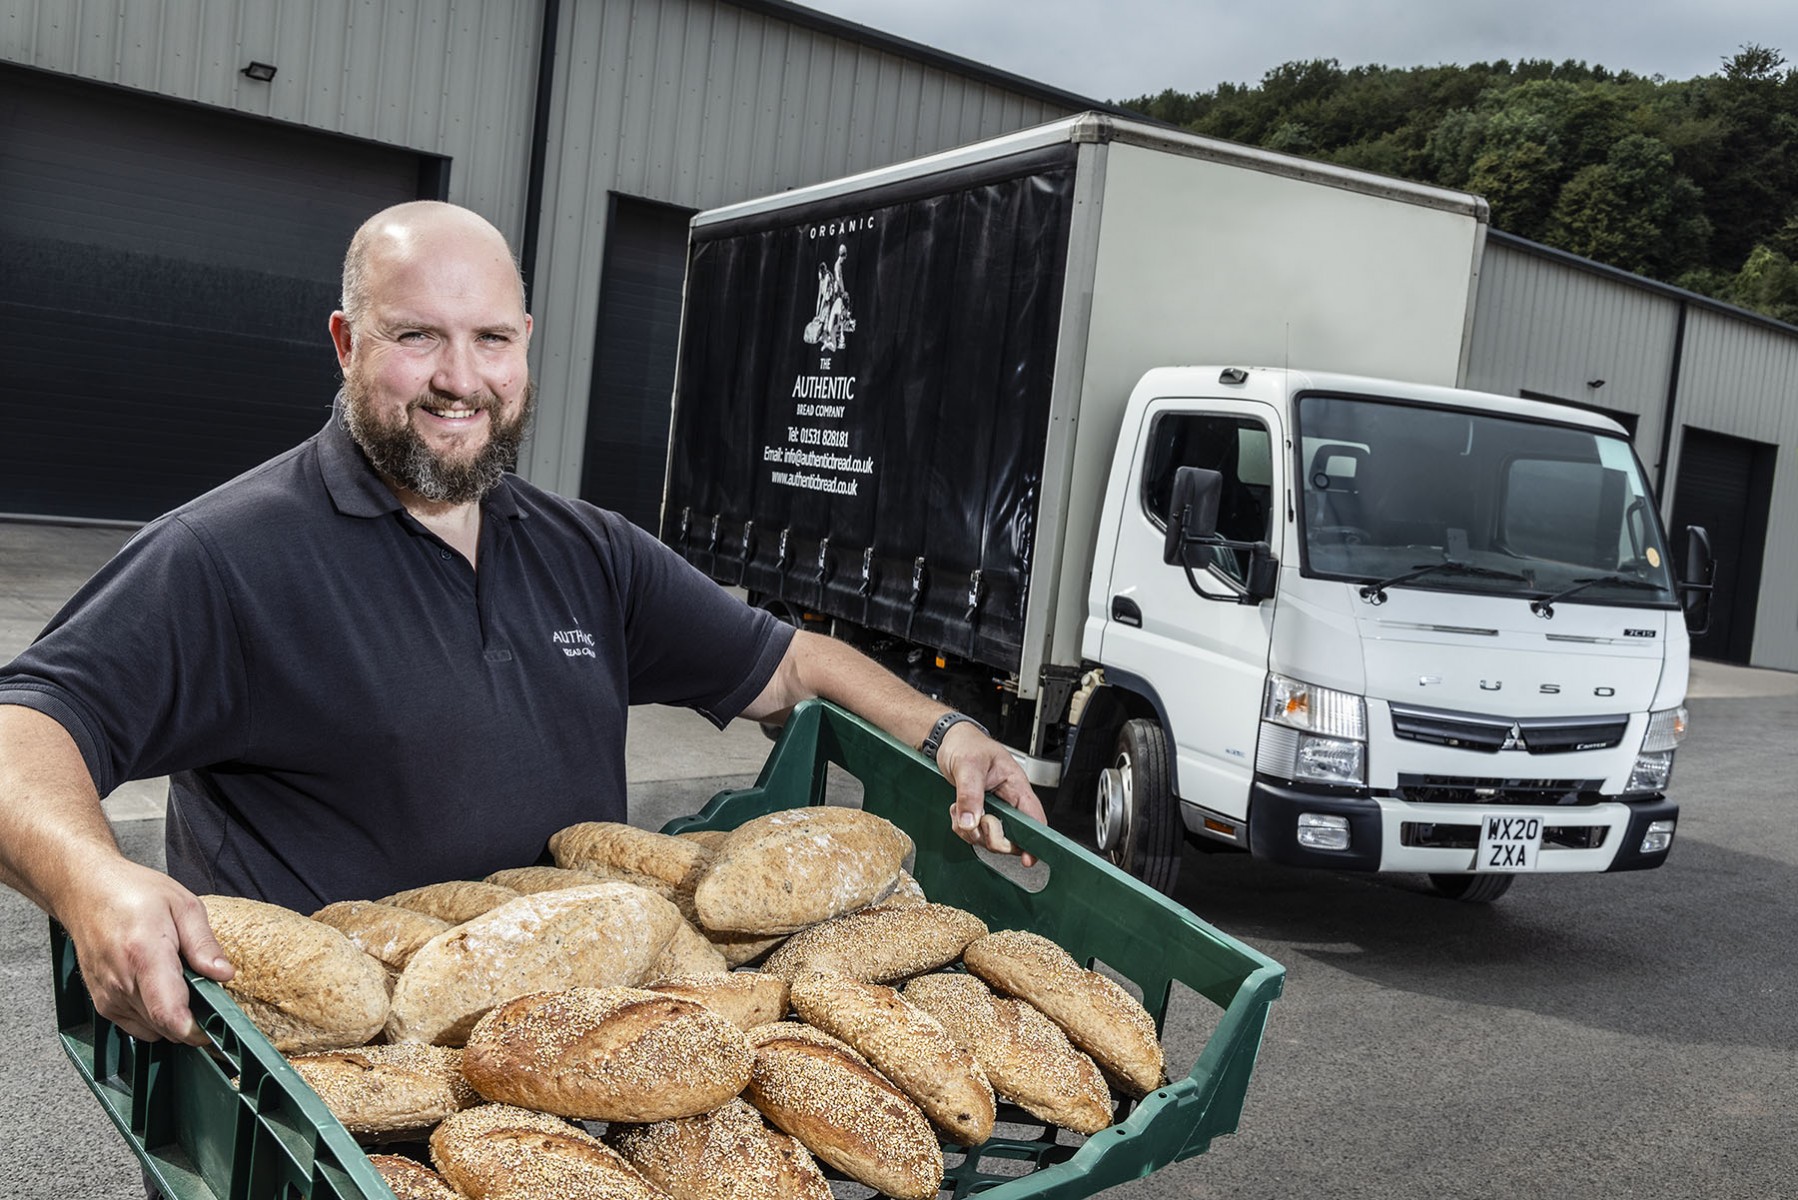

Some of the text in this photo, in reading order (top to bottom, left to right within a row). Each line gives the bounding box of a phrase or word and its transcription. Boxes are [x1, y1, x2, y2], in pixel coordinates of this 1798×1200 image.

[810, 216, 874, 239] ORGANIC
[820, 358, 831, 370] THE
[792, 375, 855, 400] AUTHENTIC
[796, 404, 845, 418] BREAD COMPANY
[788, 426, 849, 447] Tel: 01531 828181
[764, 446, 874, 474] Email: info@authenticbread.co.uk
[771, 471, 858, 496] www.authenticbread.co.uk
[1419, 675, 1616, 698] FUSO
[1488, 818, 1539, 840] WX20
[1489, 844, 1526, 866] ZXA
